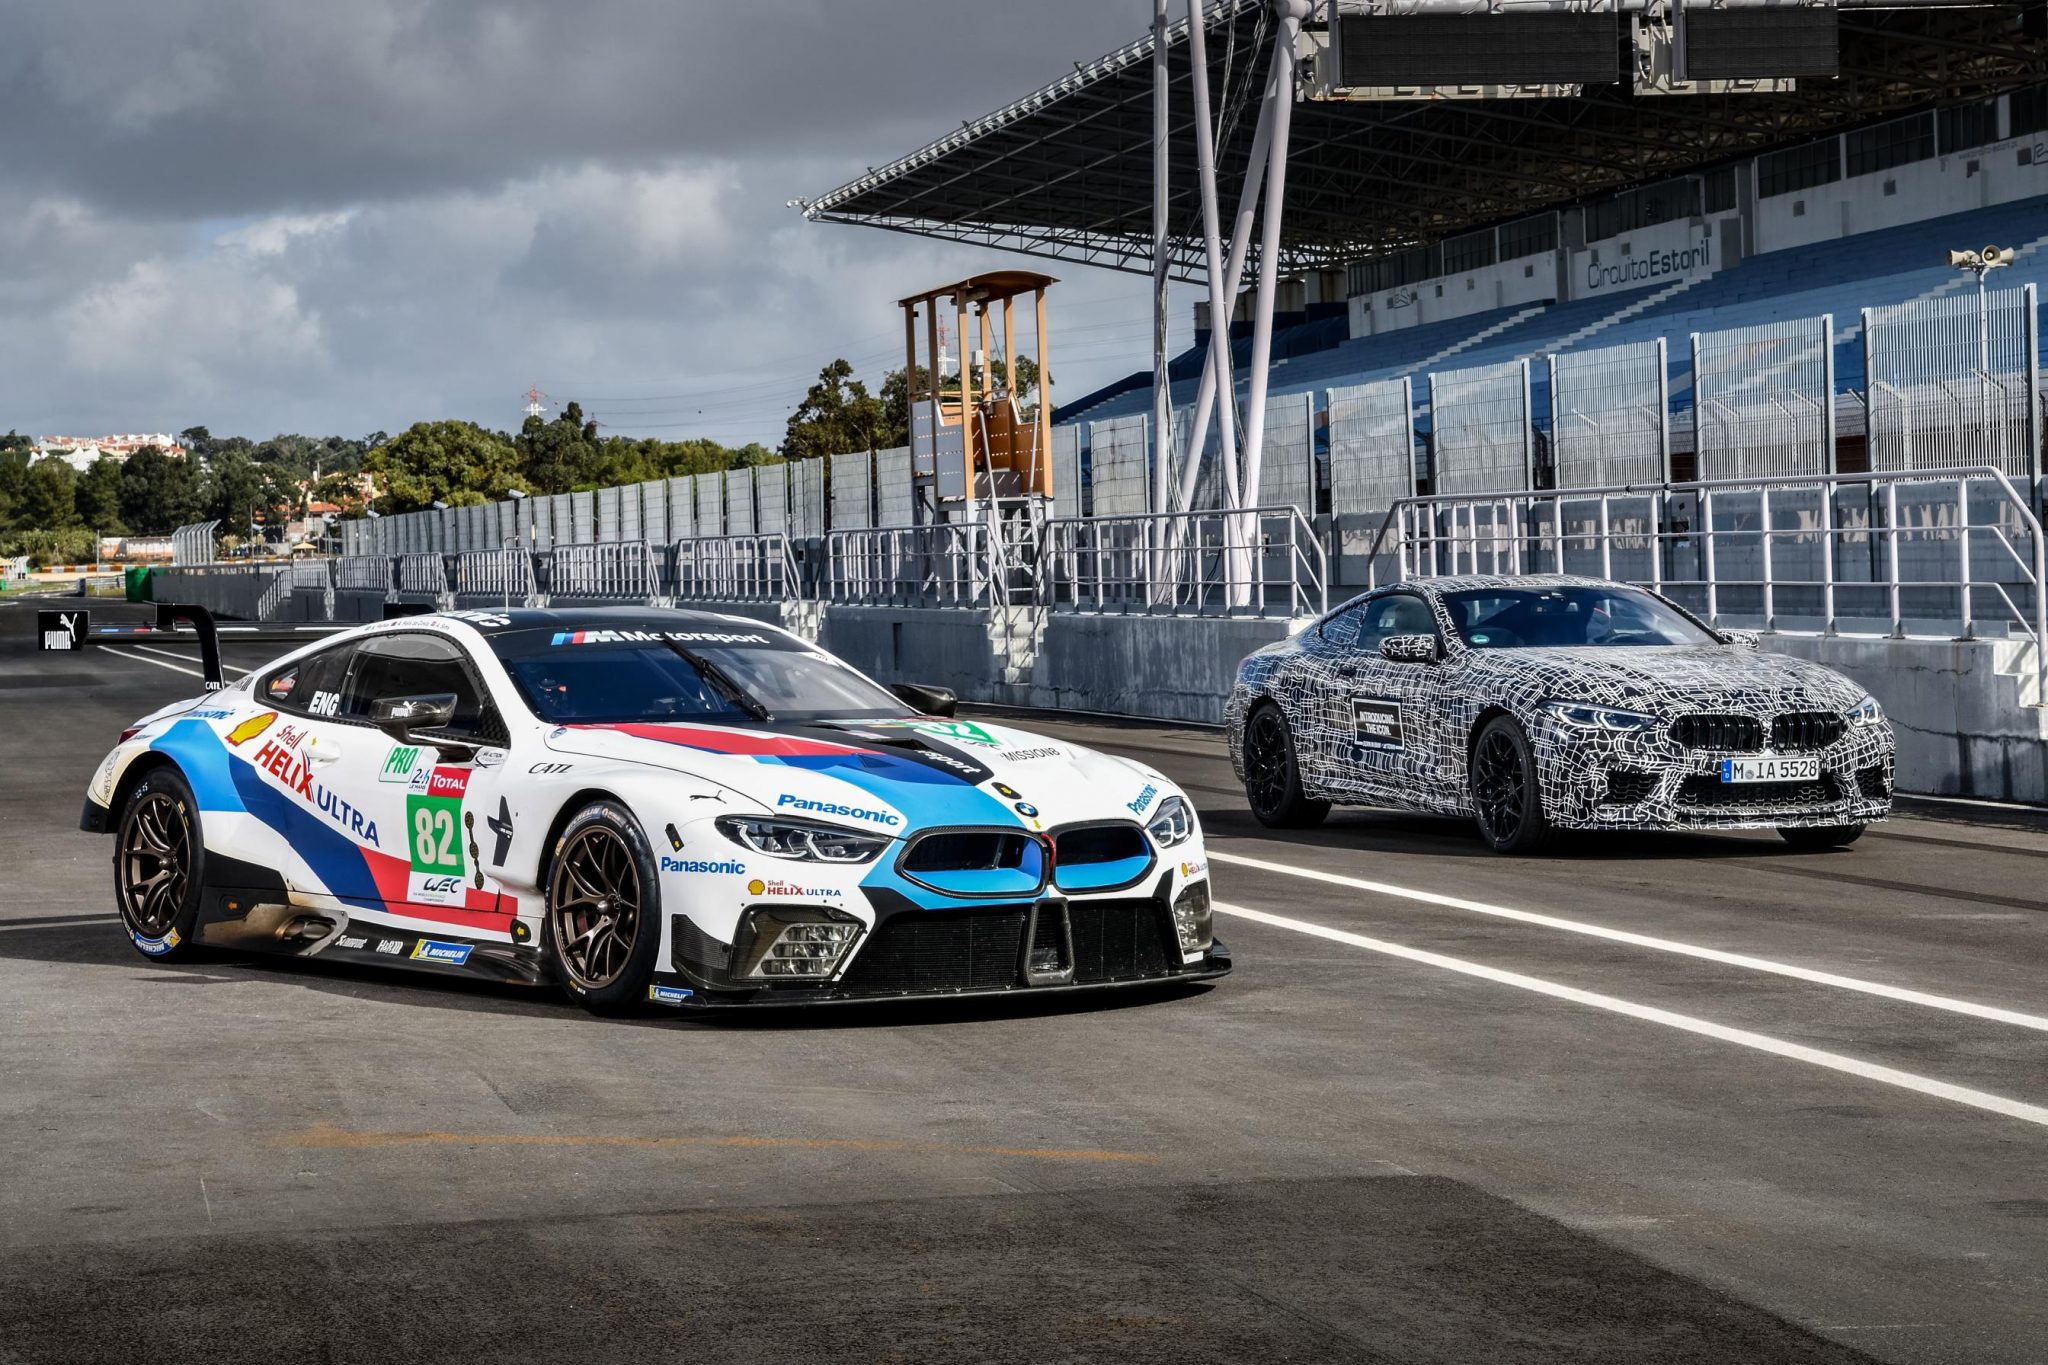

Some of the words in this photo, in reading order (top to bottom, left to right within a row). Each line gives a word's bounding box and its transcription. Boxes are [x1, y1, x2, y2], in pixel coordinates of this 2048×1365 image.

[44, 630, 72, 651] PUMA
[619, 630, 771, 644] Motorsport
[205, 681, 221, 690] CATL
[308, 690, 341, 716] ENG
[1359, 711, 1395, 725] INTRODUCING
[276, 725, 309, 750] Shell
[1365, 723, 1377, 734] THE
[1376, 725, 1391, 736] ICON
[385, 746, 419, 775] PRO
[528, 762, 574, 774] CATL
[1733, 762, 1744, 779] M
[1756, 762, 1776, 779] IA
[1780, 760, 1818, 778] 5528
[433, 774, 466, 790] TOTAL
[253, 739, 315, 803] HELIX
[317, 783, 380, 848] ULTRA
[1126, 784, 1158, 816] Panasonic
[777, 794, 900, 826] Panasonic
[415, 808, 457, 866] 82
[661, 857, 746, 875] Panasonic
[424, 877, 461, 893] WEC
[767, 883, 805, 896] HELIX
[806, 888, 842, 897] ULTRA
[429, 947, 466, 959] MICHELIN
